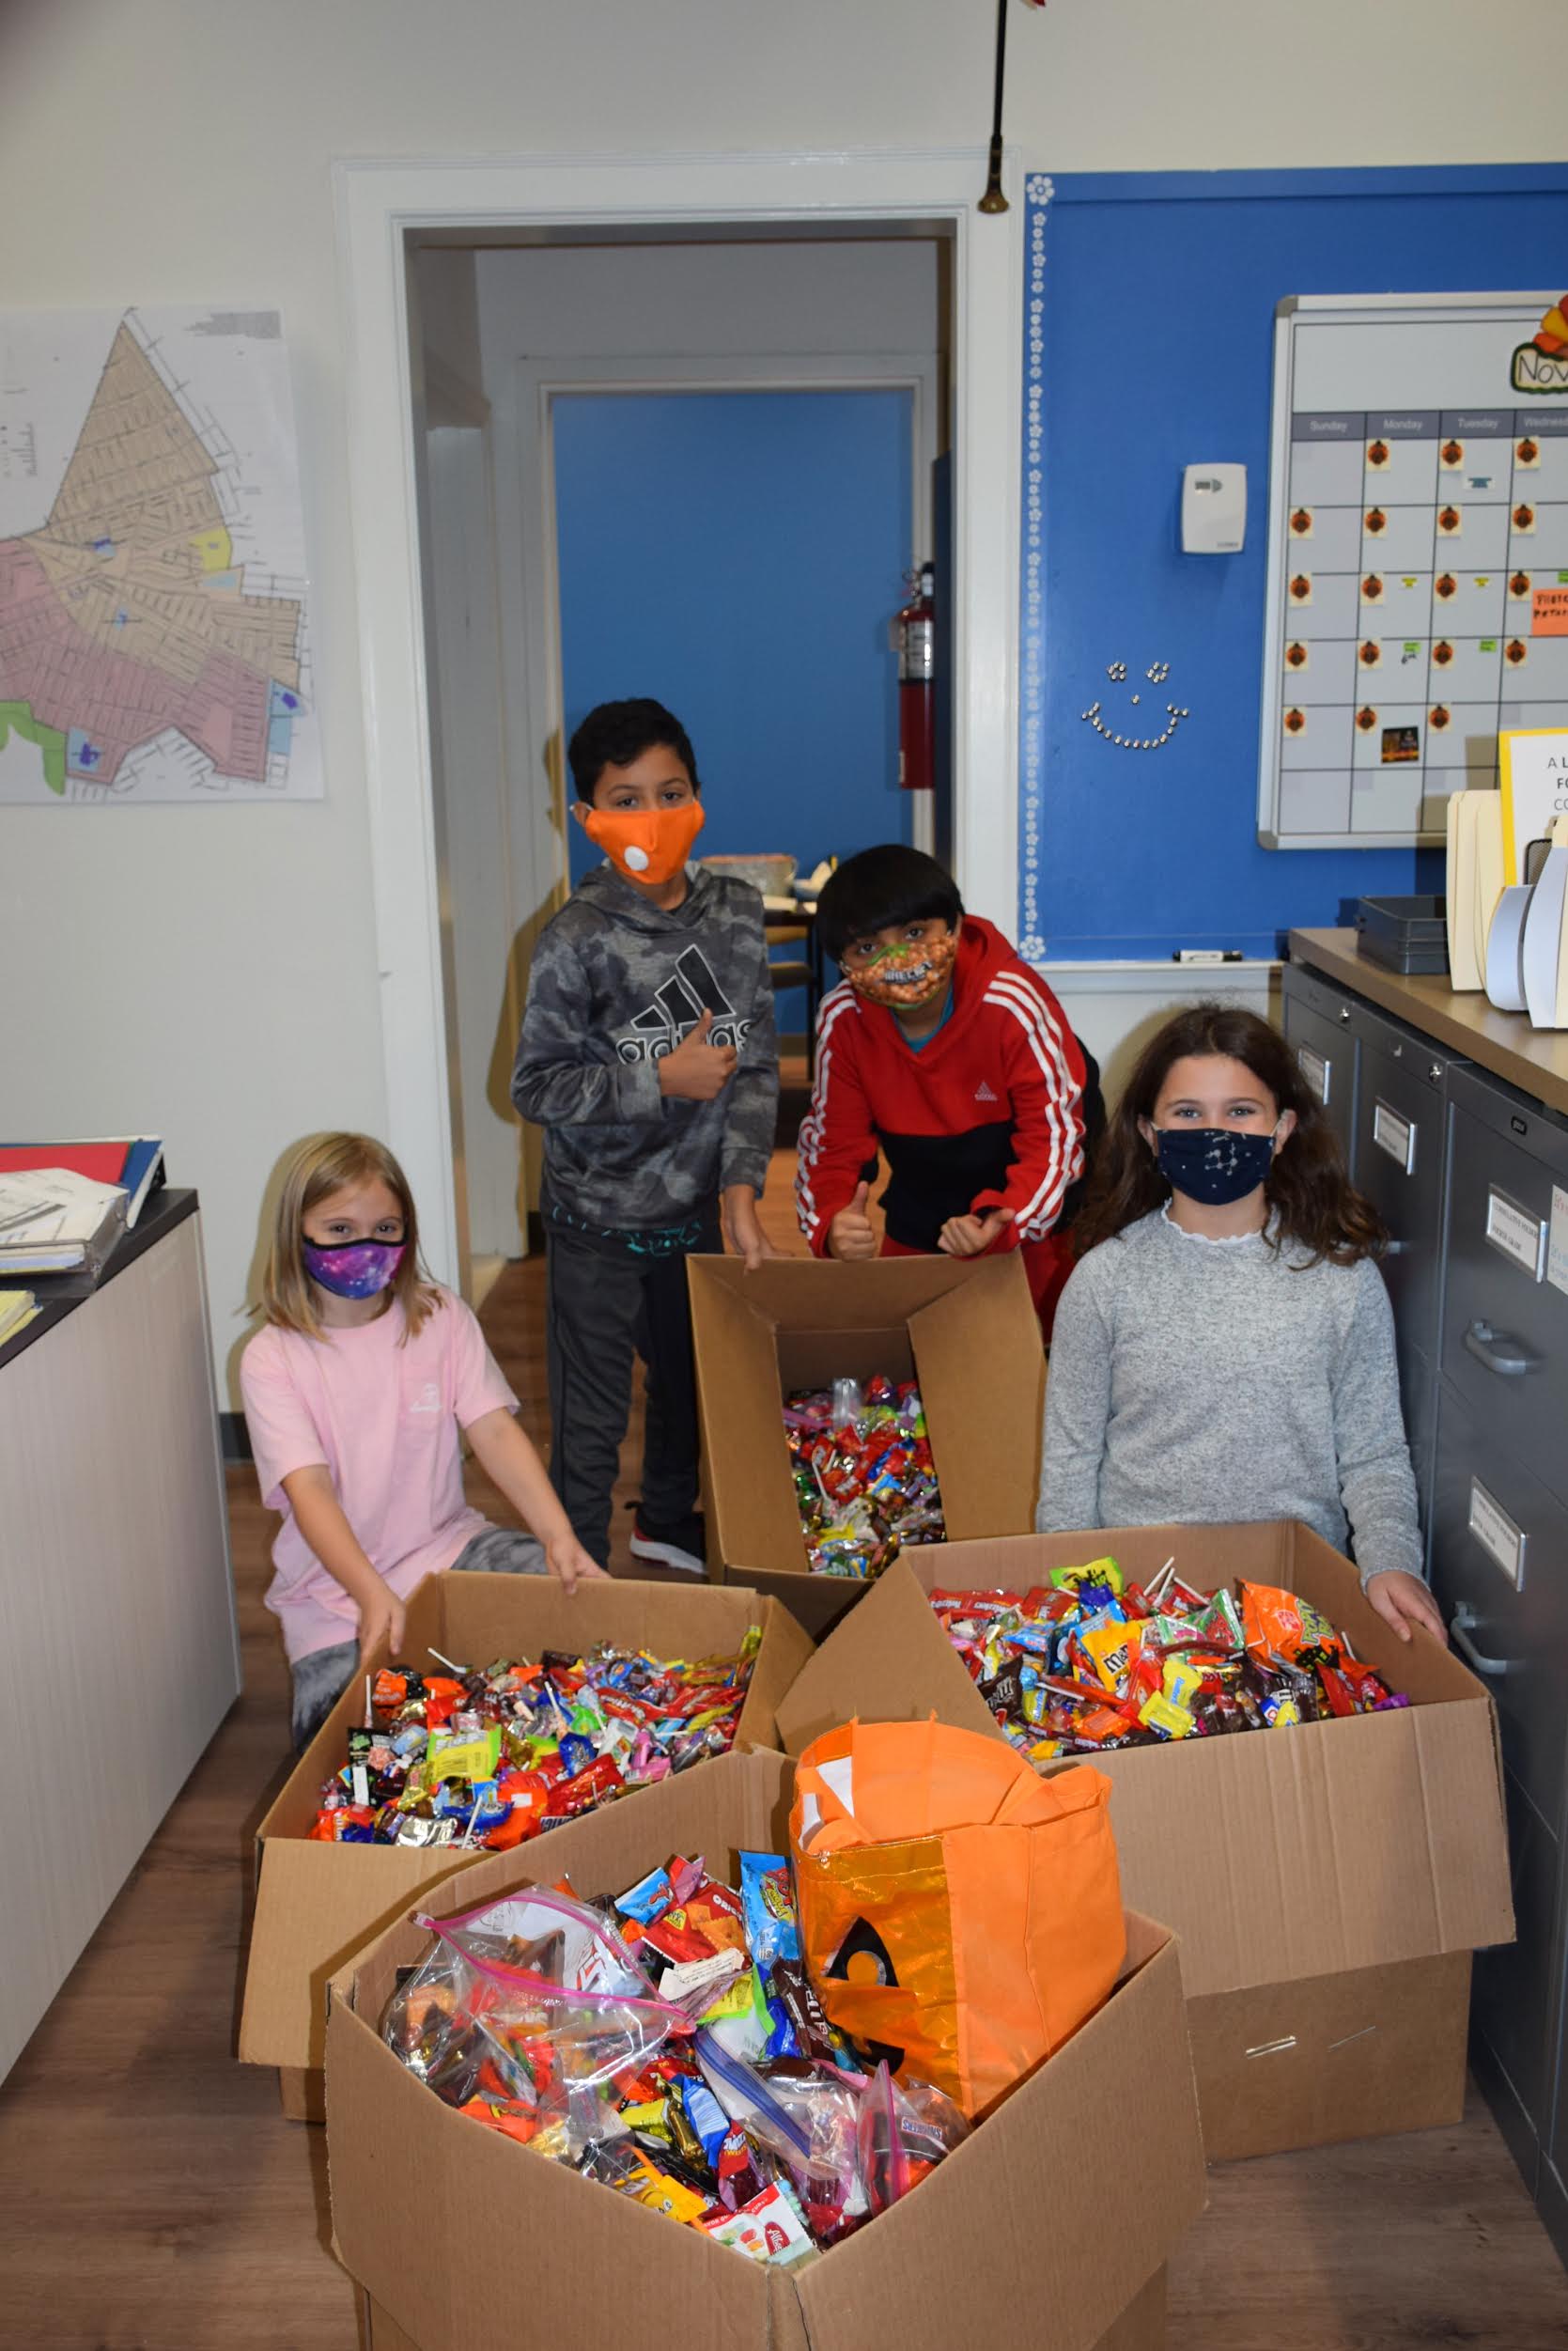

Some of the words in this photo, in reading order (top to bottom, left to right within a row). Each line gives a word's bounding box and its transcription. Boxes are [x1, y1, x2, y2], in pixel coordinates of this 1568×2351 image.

[1310, 420, 1347, 433] Sunday
[1383, 418, 1423, 431] Monday
[1458, 417, 1498, 429] Tuesday
[1547, 756, 1558, 769] A
[616, 1019, 753, 1066] adias
